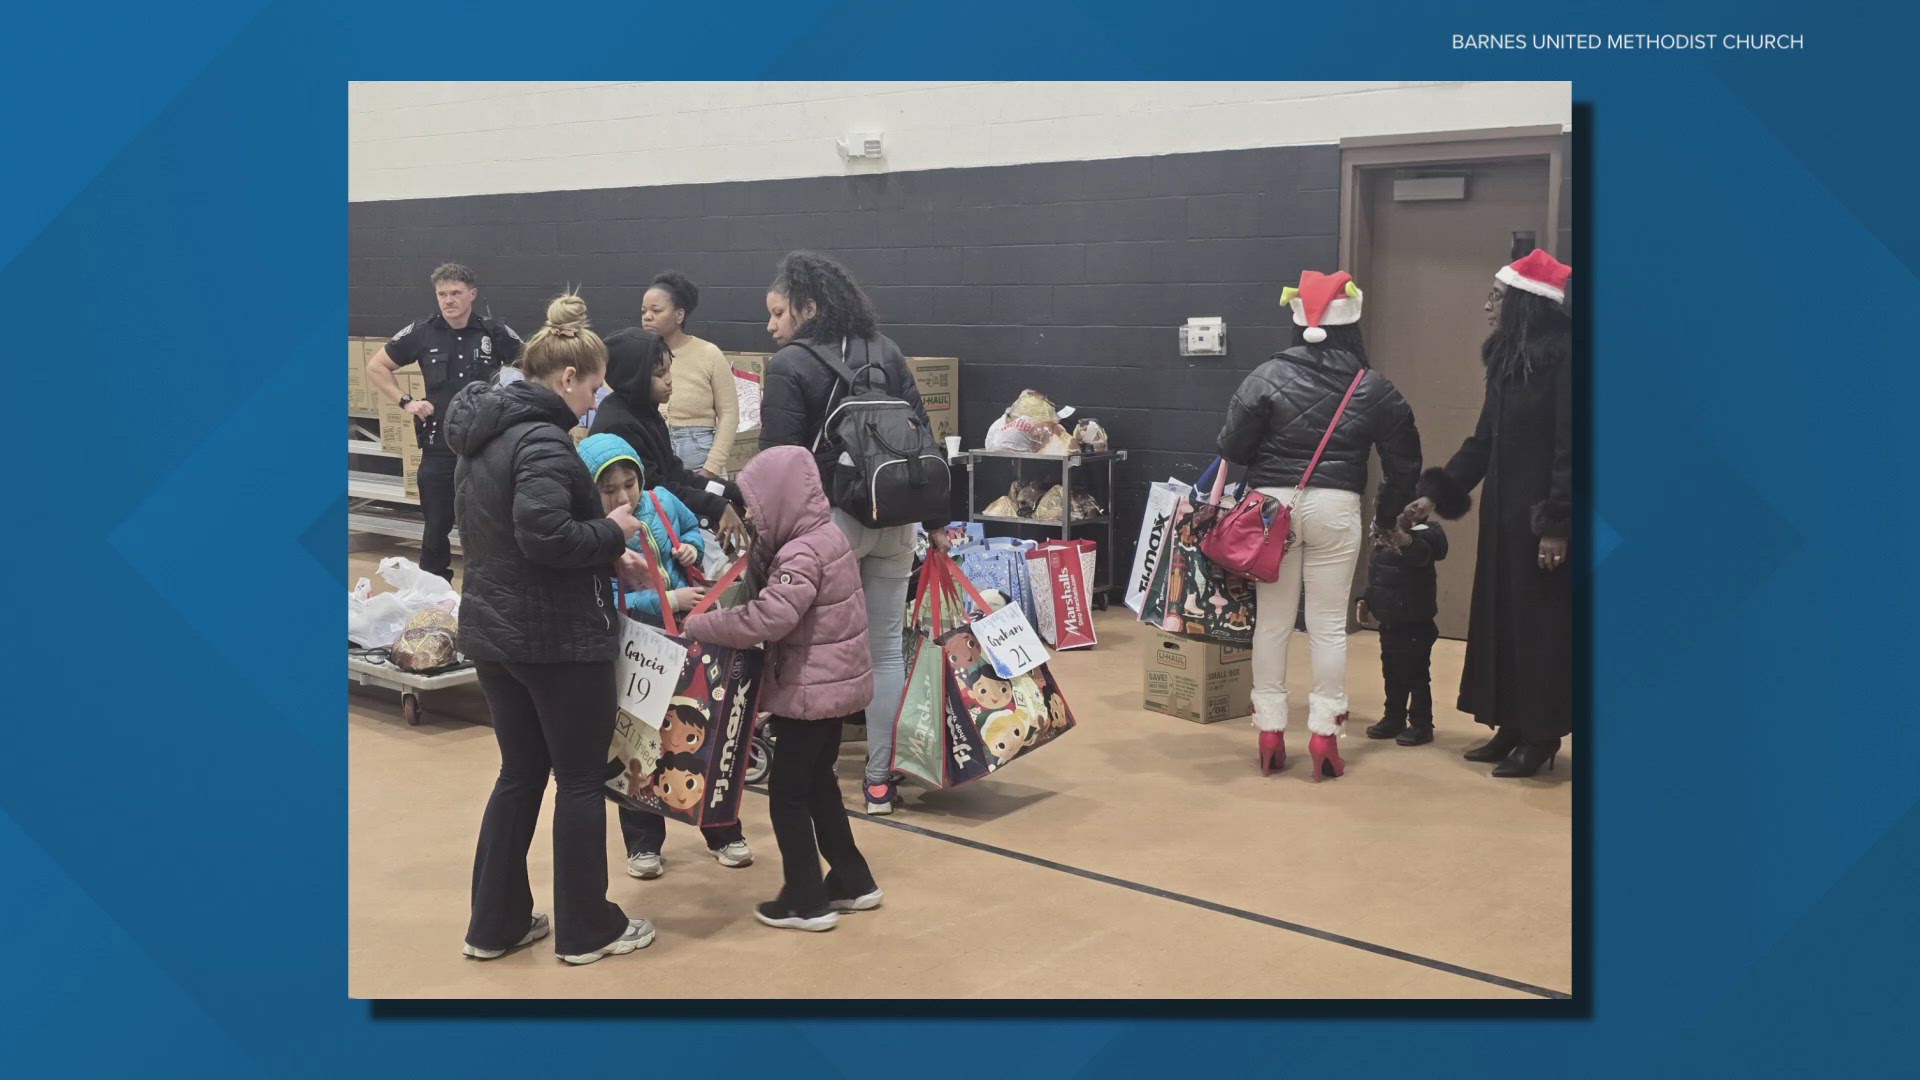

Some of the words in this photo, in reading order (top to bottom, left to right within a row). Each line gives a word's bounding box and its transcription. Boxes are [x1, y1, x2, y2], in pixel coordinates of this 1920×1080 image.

[1058, 567, 1081, 636] Marshalls
[987, 624, 1024, 647] Graham
[625, 640, 668, 675] Garcia
[1009, 644, 1032, 668] 21
[1159, 652, 1185, 664] U-HAUL
[626, 672, 651, 705] 19
[909, 674, 931, 765] Marsha
[634, 733, 659, 767] Tried
